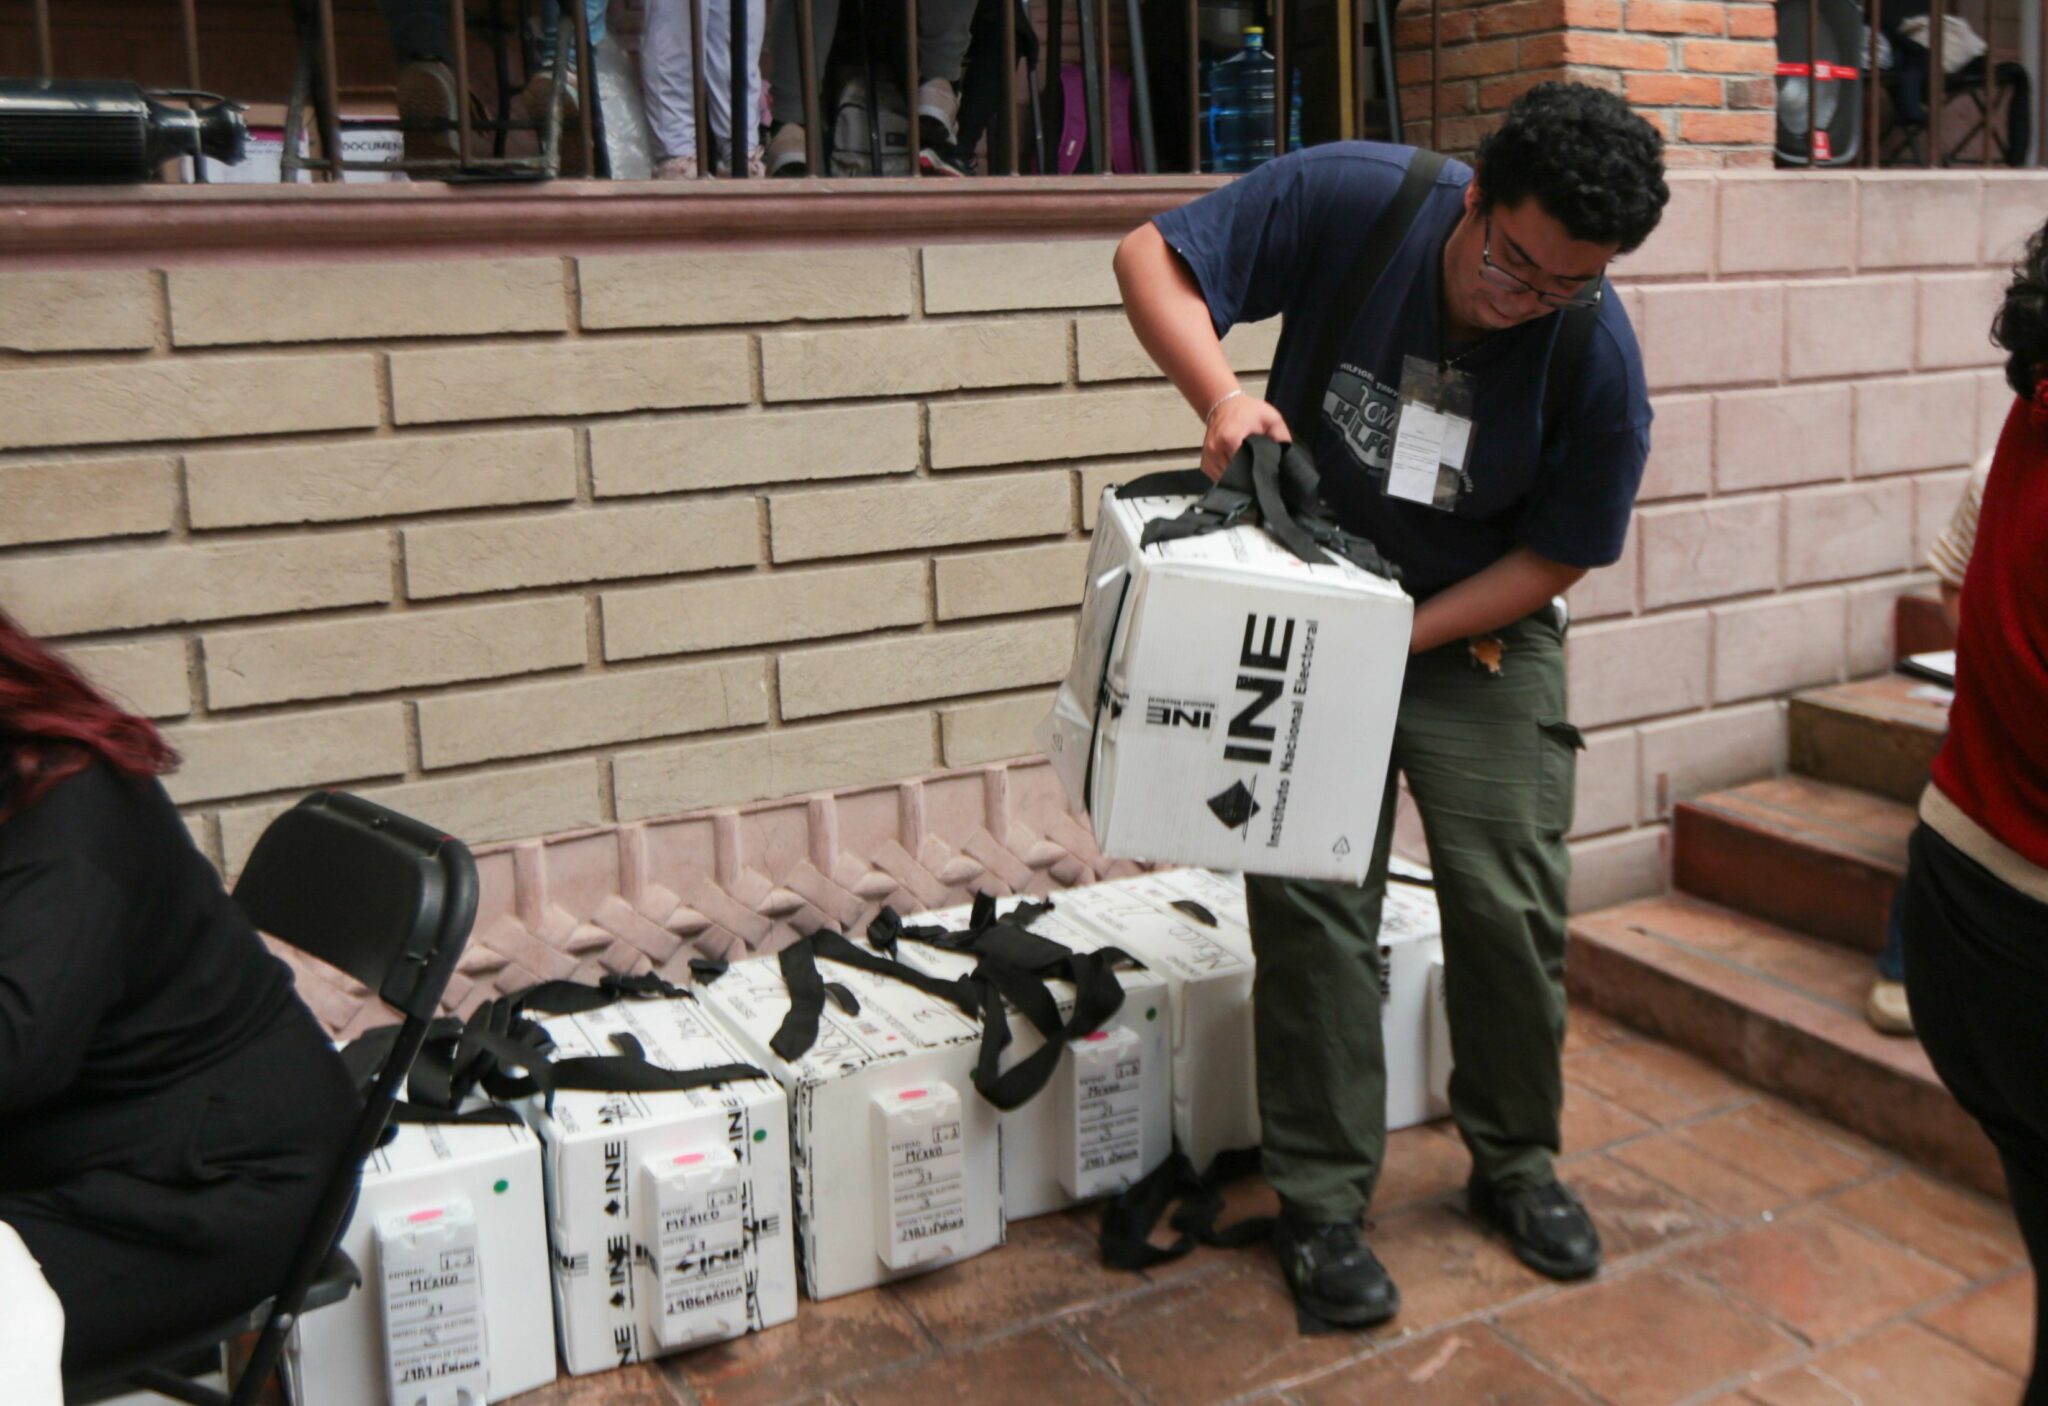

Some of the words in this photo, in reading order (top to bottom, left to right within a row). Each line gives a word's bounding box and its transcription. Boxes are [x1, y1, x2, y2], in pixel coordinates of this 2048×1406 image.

[341, 140, 402, 153] DOCUMEN
[1224, 612, 1296, 764] INE
[1294, 619, 1320, 695] Electoral
[1145, 704, 1212, 730] INE
[1278, 698, 1308, 775] Nacional
[1266, 779, 1291, 849] Instituto
[604, 1140, 622, 1194] INE
[614, 1324, 632, 1367] NE
